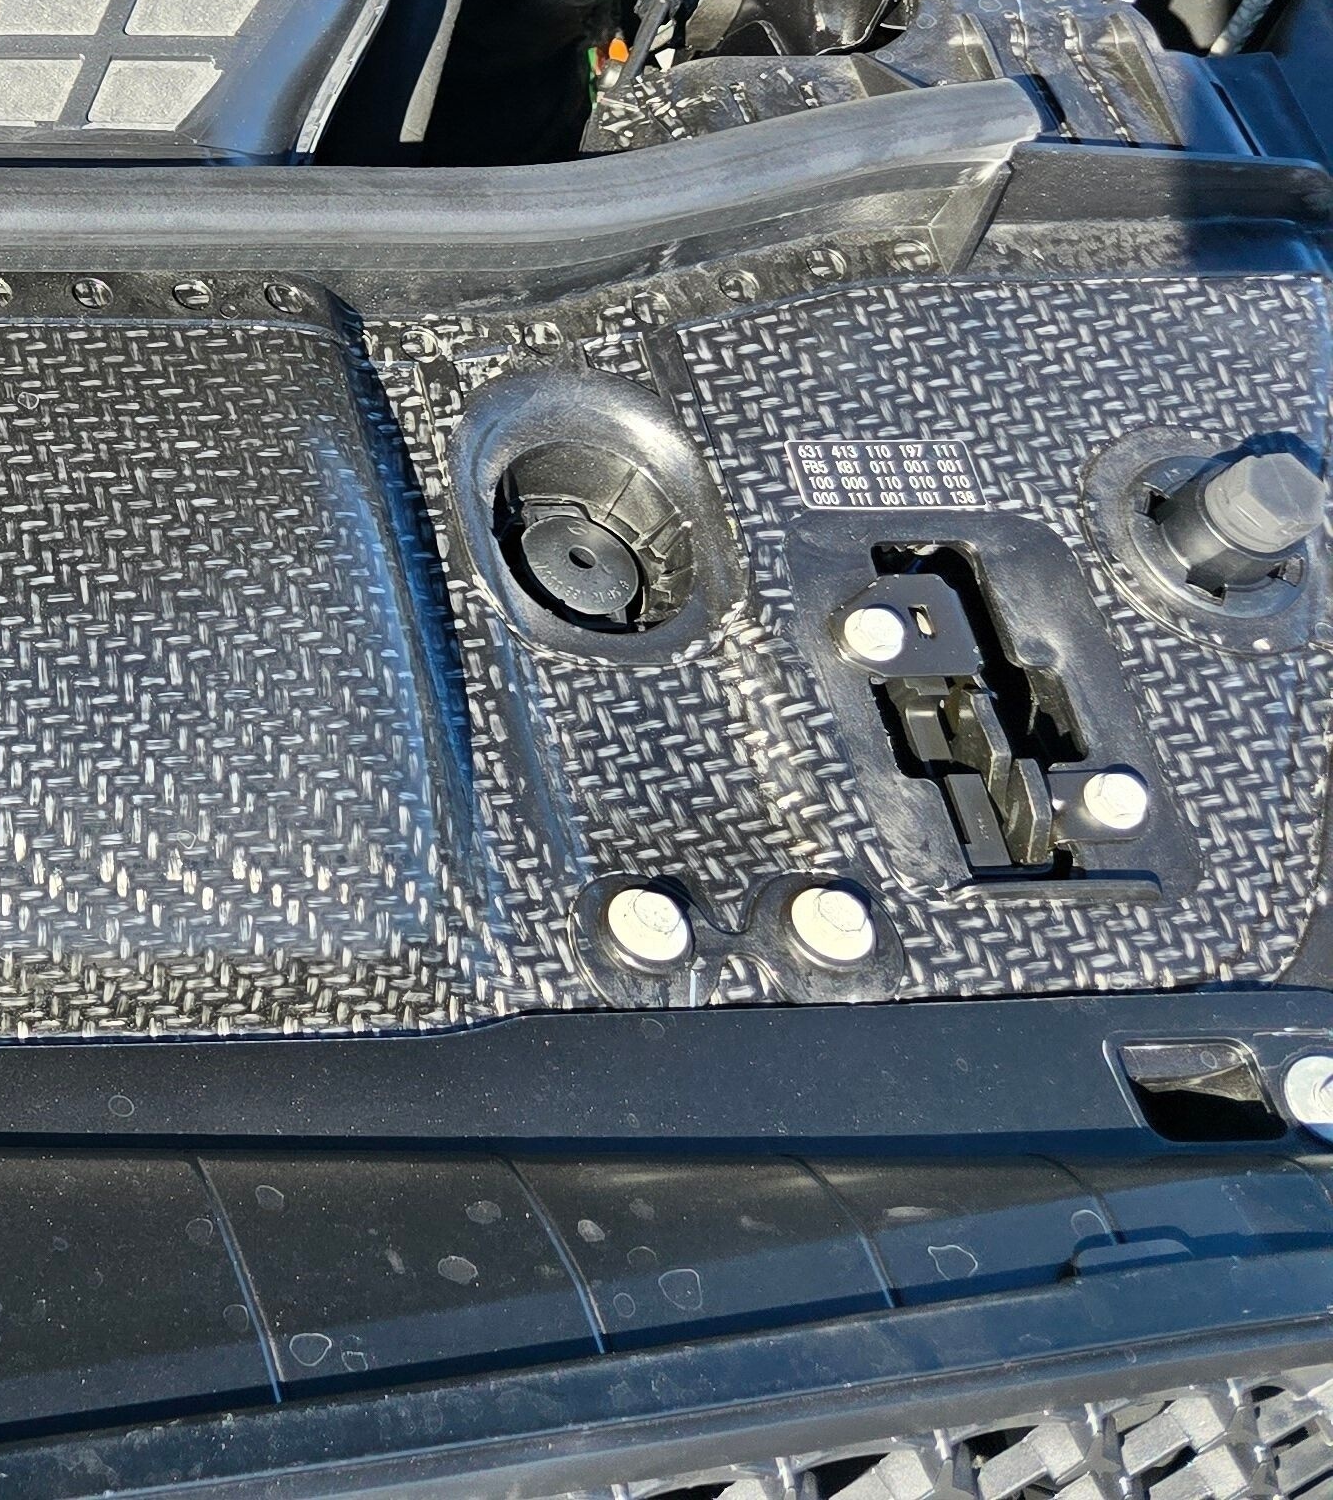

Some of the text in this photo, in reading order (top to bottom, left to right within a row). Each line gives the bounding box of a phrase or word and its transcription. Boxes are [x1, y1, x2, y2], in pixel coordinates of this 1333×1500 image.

[798, 443, 957, 459] 631 413 110 197 111
[802, 459, 963, 474] FB5 KB1 011 001 001
[809, 475, 971, 490] 100 000 110 010 010
[813, 490, 977, 506] 000 111 001 101 138
